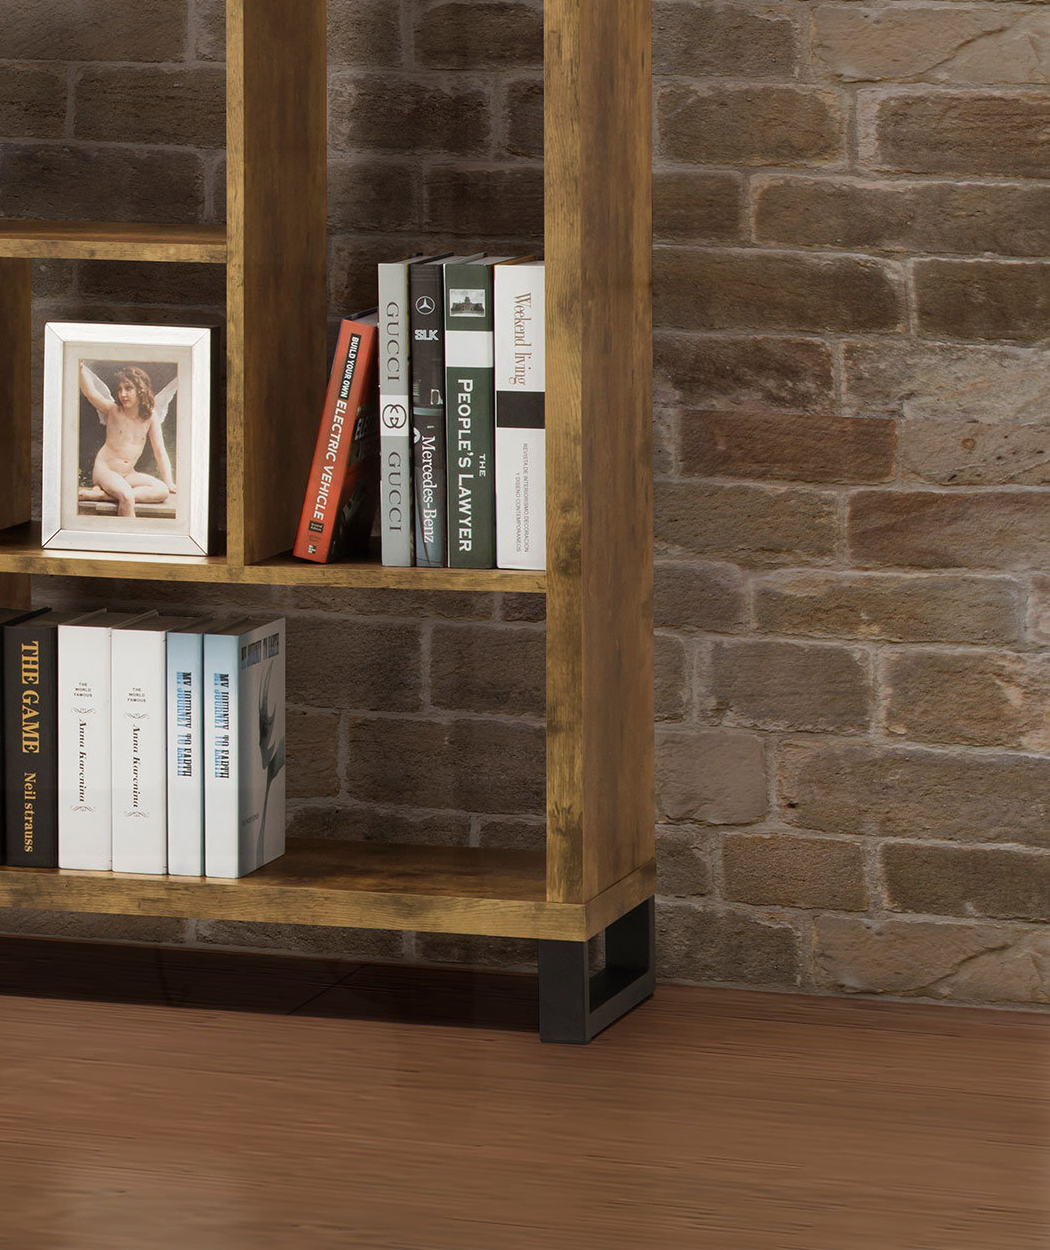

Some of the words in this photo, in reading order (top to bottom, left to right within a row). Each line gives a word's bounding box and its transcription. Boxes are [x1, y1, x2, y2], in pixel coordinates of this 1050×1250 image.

[414, 329, 439, 341] SLK
[514, 292, 532, 352] Weekend
[347, 336, 360, 359] BUILD
[385, 301, 400, 381] GUCCI
[343, 359, 355, 380] YOUR
[508, 353, 532, 386] living
[339, 379, 351, 399] OWN
[325, 399, 347, 463] ELECTRIC
[457, 378, 474, 468] PEOPLE'S
[422, 435, 437, 543] Mercedes-Benz
[523, 466, 528, 475] DE
[312, 465, 335, 521] VEHICLE
[388, 450, 402, 532] GUCCI
[458, 473, 472, 552] LAWYER
[21, 640, 39, 685] THE
[176, 671, 192, 687] MY
[213, 673, 229, 688] MY
[22, 689, 40, 754] GAME
[176, 687, 192, 729] JOURNEY
[213, 689, 229, 731] JOURNEY
[79, 719, 87, 748] Anna
[133, 724, 141, 753] Anna
[176, 733, 192, 745] TO
[214, 734, 229, 747] TO
[79, 751, 87, 802] Karenina
[176, 747, 192, 777] EARTH
[214, 749, 230, 779] EARTH
[24, 772, 36, 800] Neil
[133, 756, 141, 808] Karenina
[24, 801, 33, 853] strauss
